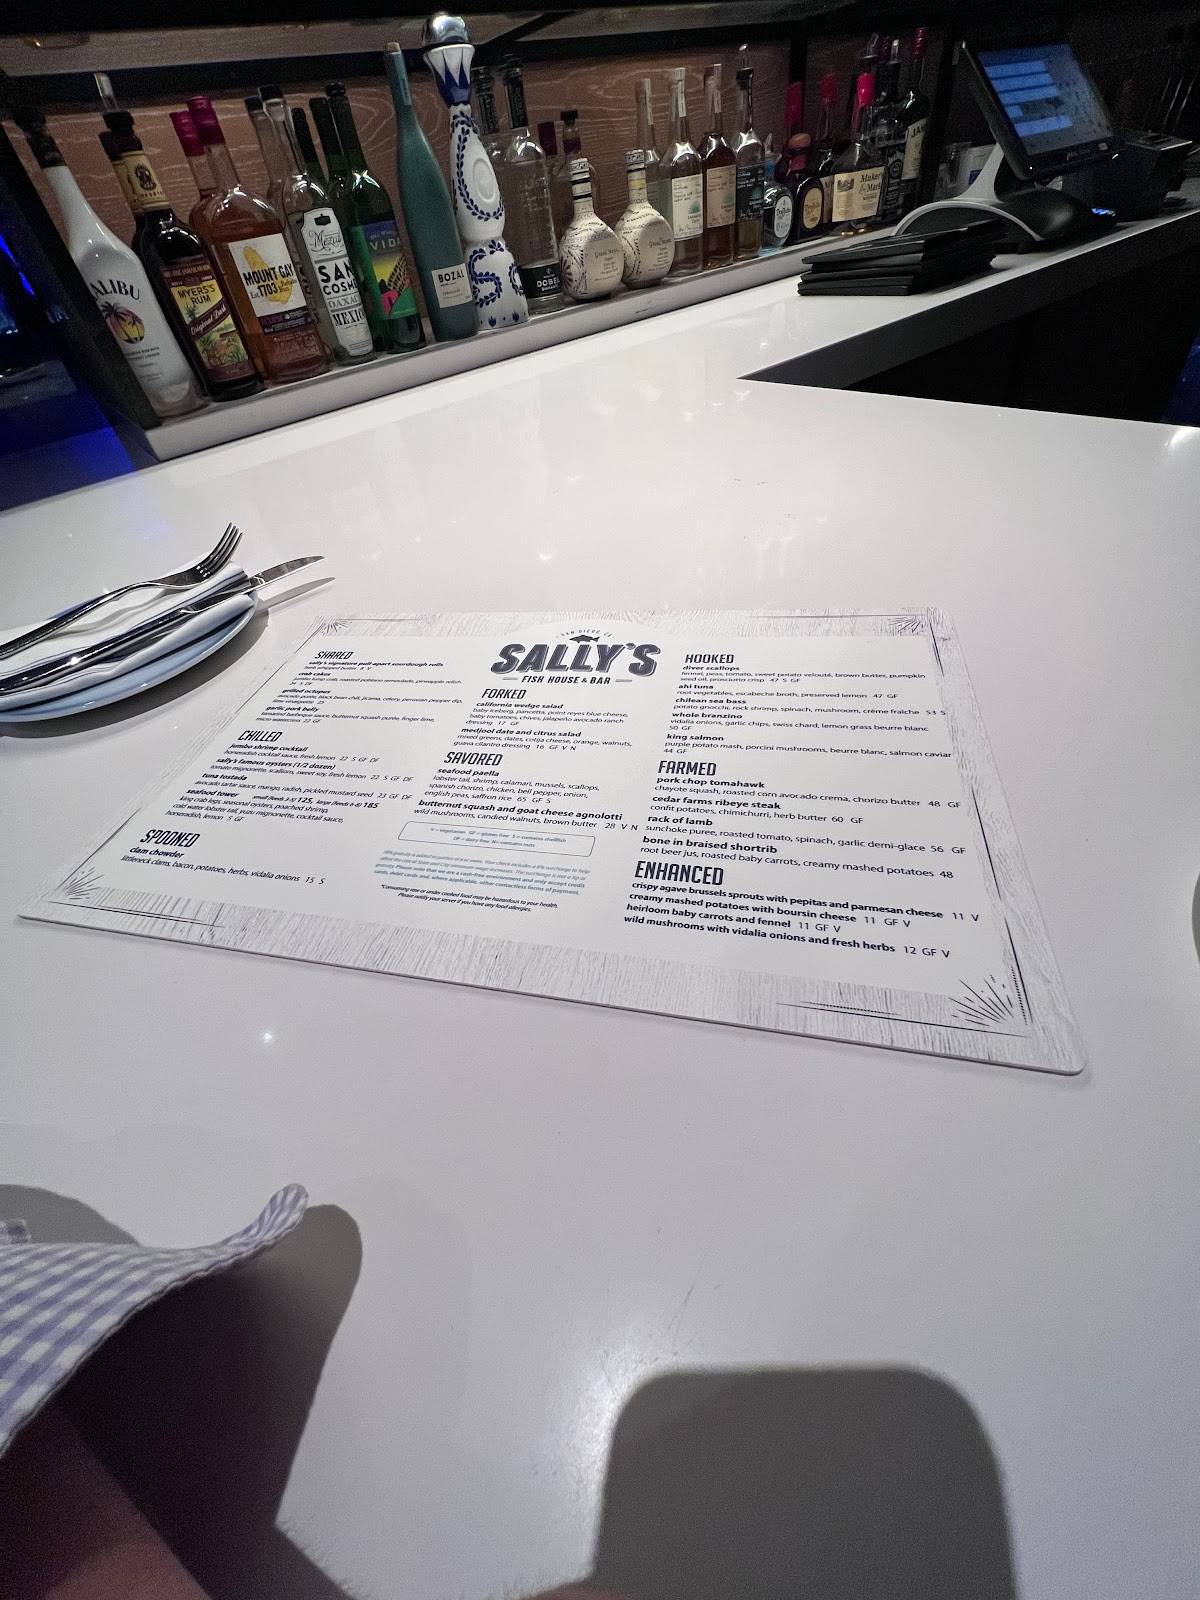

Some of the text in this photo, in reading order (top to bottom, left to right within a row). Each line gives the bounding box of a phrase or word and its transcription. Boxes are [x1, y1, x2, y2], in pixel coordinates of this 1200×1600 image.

[243, 267, 279, 287] MOUNT
[279, 263, 294, 279] GAY
[536, 276, 561, 288] DOBEL
[90, 278, 141, 301] ALIBU
[257, 282, 278, 298] 1703
[191, 294, 212, 306] RUM
[332, 308, 366, 328] MEXIC
[314, 651, 353, 659] SHARED
[490, 642, 661, 677] SALLY'S
[685, 654, 734, 663] HOOKED
[521, 675, 545, 684] FISH
[547, 676, 581, 684] HOUSE
[589, 677, 611, 685] BAR
[481, 688, 526, 699] FORKED
[238, 730, 282, 742] CHILLED
[444, 751, 502, 765] SAVORED
[658, 760, 716, 776] FARMED
[682, 778, 707, 786] chop
[418, 800, 462, 808] butternut
[683, 796, 712, 804] farms
[715, 799, 748, 808] ribeye
[685, 817, 712, 825] lamb
[140, 829, 200, 847] SPOONED
[642, 835, 670, 844] bone
[686, 839, 727, 849] braised
[730, 843, 777, 853] shortrib
[148, 849, 184, 858] chowder
[120, 855, 151, 863] littleneck
[150, 858, 171, 866] clams,
[172, 860, 194, 869] bacon,
[194, 865, 226, 873] potatoes,
[227, 868, 248, 876] herbs,
[635, 861, 723, 885] ENHANCED
[632, 882, 658, 891] crispy
[688, 886, 726, 896] brussels
[728, 892, 764, 900] sprouts
[790, 898, 827, 906] pepitas
[851, 904, 903, 914] parmesan
[905, 908, 943, 918] cheese
[971, 913, 979, 921] V
[626, 903, 669, 914] heirloom
[672, 908, 696, 918] baby
[698, 912, 733, 921] carrots
[757, 917, 790, 927] fennel
[799, 921, 808, 930] 11
[815, 923, 829, 931] GF
[629, 894, 663, 903] creamy
[665, 897, 703, 906] mashed
[705, 901, 749, 910] potatoes
[751, 905, 774, 913] with
[776, 907, 817, 917] boursin
[819, 911, 856, 922] cheese
[864, 916, 875, 924] 11
[902, 919, 910, 927] V
[646, 919, 704, 930] mushrooms
[707, 924, 729, 933] with
[732, 927, 766, 937] vidalia
[769, 932, 806, 942] onions
[831, 937, 860, 948] fresh
[862, 941, 895, 951] herbs
[904, 946, 916, 954] 12
[921, 947, 936, 956] GF
[941, 949, 950, 958] V
